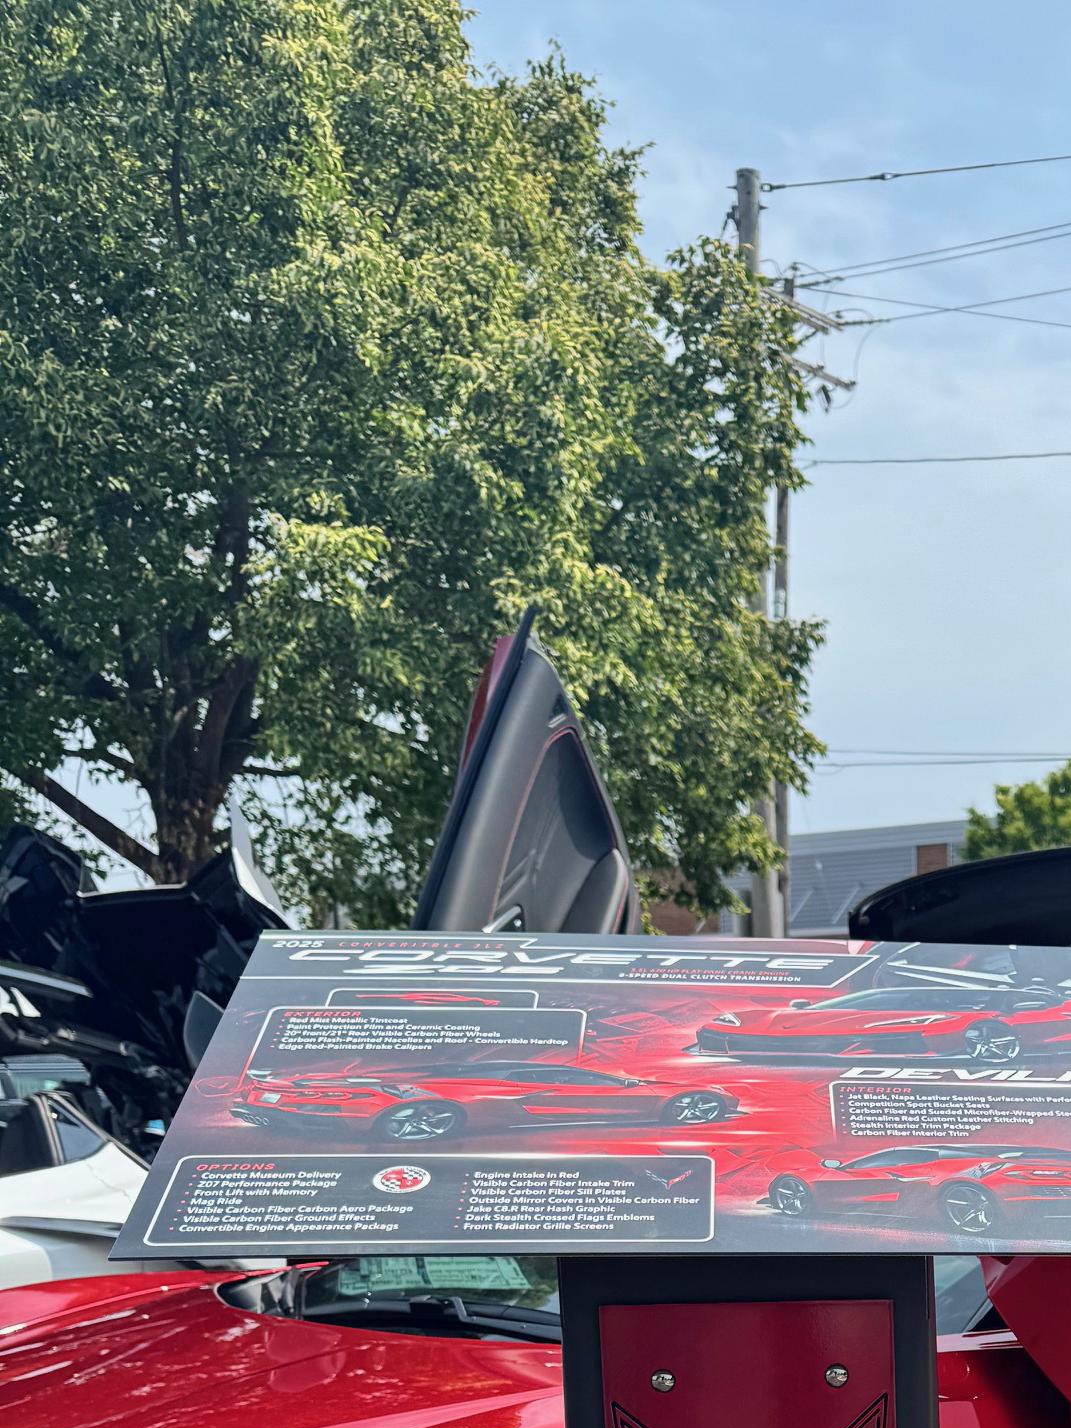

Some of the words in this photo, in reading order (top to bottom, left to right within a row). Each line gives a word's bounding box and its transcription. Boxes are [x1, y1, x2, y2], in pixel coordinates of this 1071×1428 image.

[272, 940, 326, 948] 2025
[289, 950, 834, 969] CORVETTE
[343, 964, 564, 975] Z06
[444, 1024, 481, 1033] Coating
[839, 1087, 912, 1095] INTERIOR
[848, 1100, 905, 1108] Competition
[964, 1109, 1054, 1118] Microfiber-Wrapped
[993, 1116, 1034, 1124] Stitching
[196, 1163, 275, 1171] OPTIONS
[249, 1170, 296, 1179] Museum
[297, 1170, 342, 1180] Delivery
[474, 1171, 511, 1180] Engine
[292, 1179, 338, 1188] Package
[272, 1188, 318, 1197] Memory
[190, 1197, 216, 1206] Mag
[368, 1204, 414, 1214] Package
[575, 1205, 616, 1214] Graphic
[264, 1214, 294, 1222] Fiber
[294, 1213, 337, 1222] Ground
[577, 1213, 605, 1222] Flags
[178, 1223, 244, 1232] Convertible
[245, 1223, 285, 1233] Engine
[285, 1222, 353, 1232] Appearance
